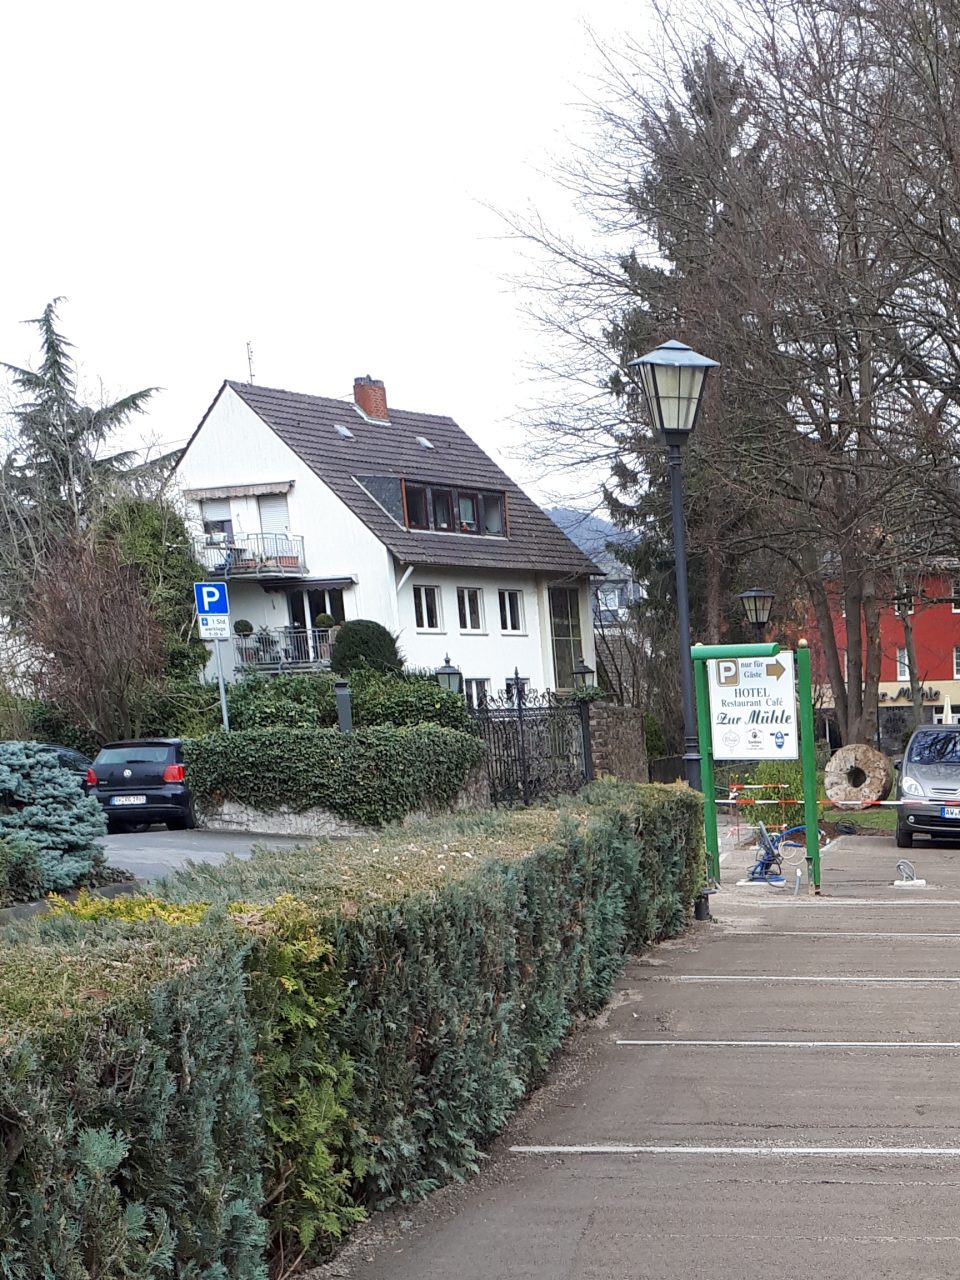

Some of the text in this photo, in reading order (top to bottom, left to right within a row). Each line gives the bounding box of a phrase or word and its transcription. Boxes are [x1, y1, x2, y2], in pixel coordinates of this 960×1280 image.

[202, 587, 220, 611] P
[719, 661, 737, 684] P
[734, 687, 771, 698] HOTEL
[721, 697, 784, 708] Restaurant Café
[716, 709, 792, 725] Zur Mühle
